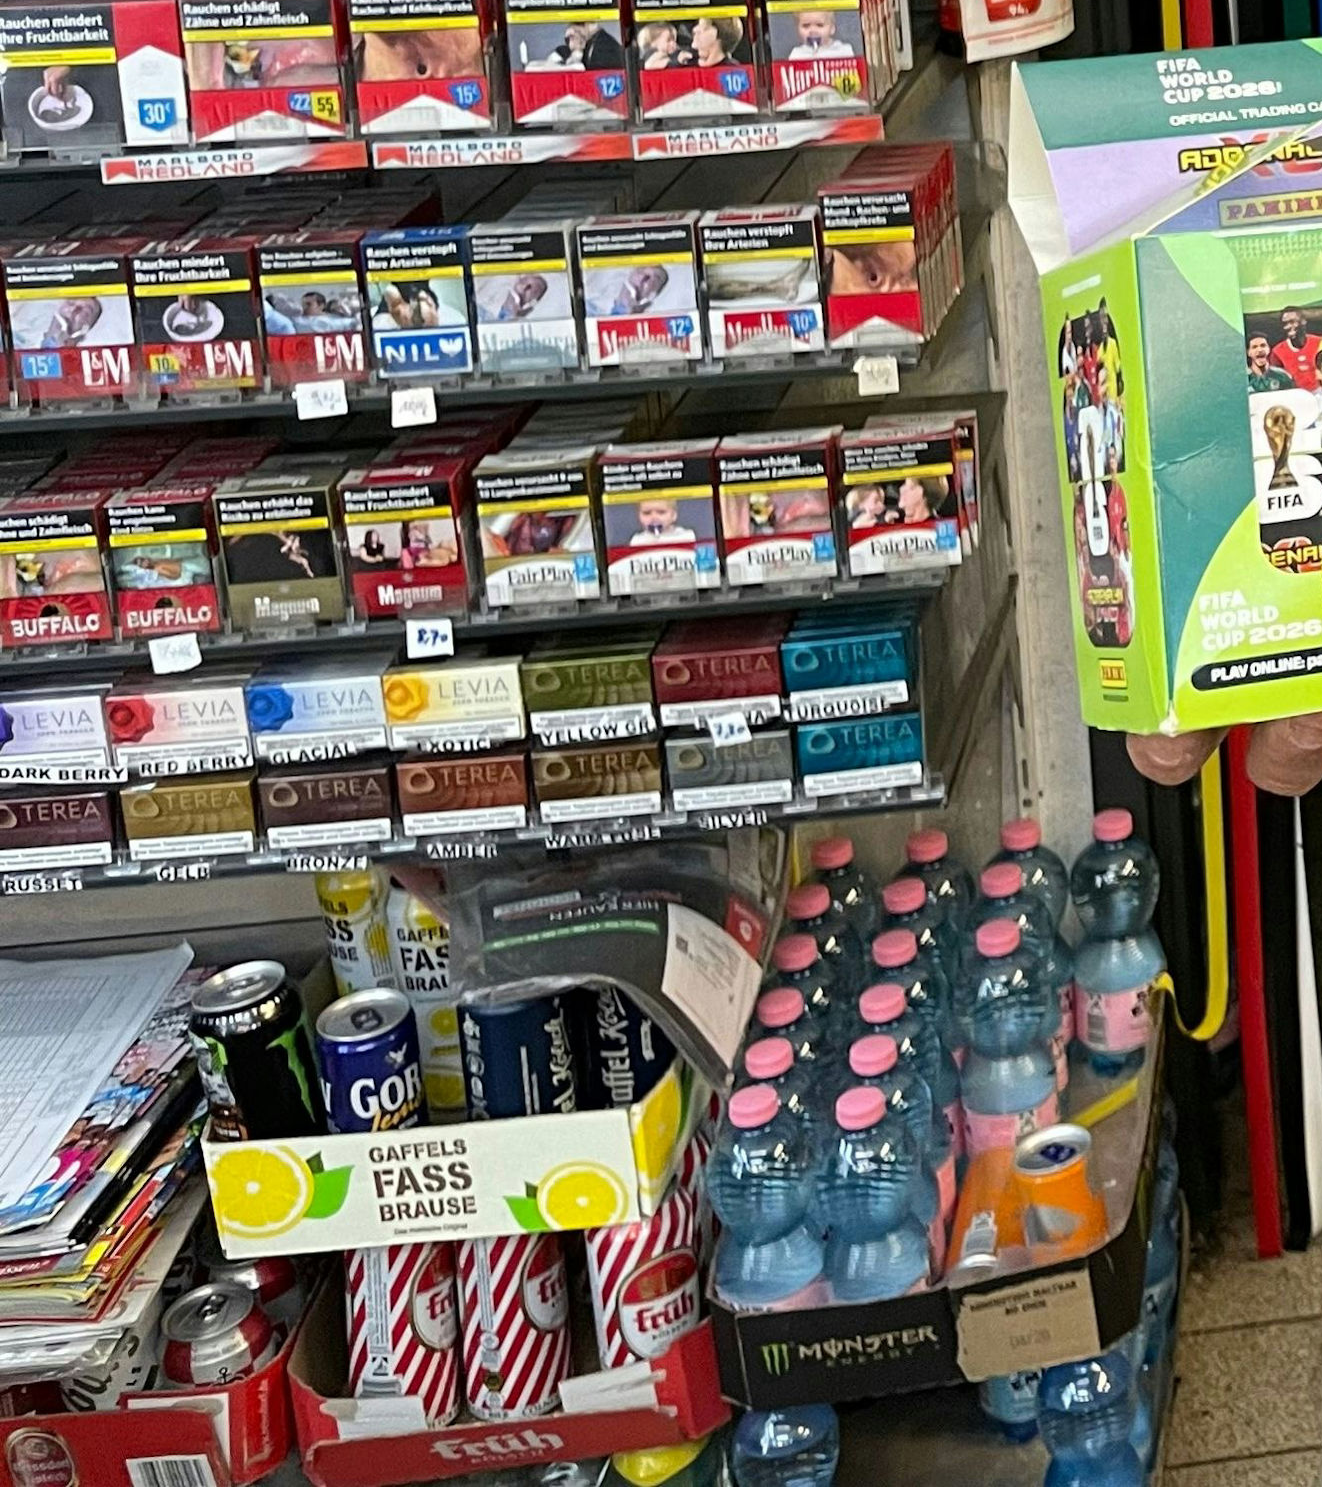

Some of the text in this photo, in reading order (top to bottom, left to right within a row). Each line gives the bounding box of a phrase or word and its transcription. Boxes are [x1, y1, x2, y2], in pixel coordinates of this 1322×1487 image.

[1157, 58, 1201, 73] FIFA
[1159, 70, 1233, 88] WORLD
[1164, 81, 1276, 104] CUP 2026
[1169, 112, 1237, 126] OFFICIAL
[1239, 103, 1306, 119] TRADING
[138, 152, 254, 166] MARLBORO
[138, 163, 254, 179] REDLAND
[385, 343, 438, 364] NIL
[81, 349, 129, 386] L&M
[1267, 494, 1304, 510] FIFA
[11, 615, 100, 637] BUFFALO
[1211, 666, 1248, 682] PLAY
[1250, 657, 1305, 676] ONLINE:
[163, 700, 234, 721] LEVIA
[141, 753, 250, 775] RED BERRY
[21, 801, 101, 822] TEREA
[287, 856, 364, 870] BRONZE
[5, 878, 80, 892] RUSSET
[369, 1139, 467, 1163] GAFFELS
[373, 1161, 473, 1198] FASS
[379, 1195, 478, 1221] BRAUSE
[799, 1324, 938, 1360] MONSTER
[430, 1430, 564, 1460] früh
